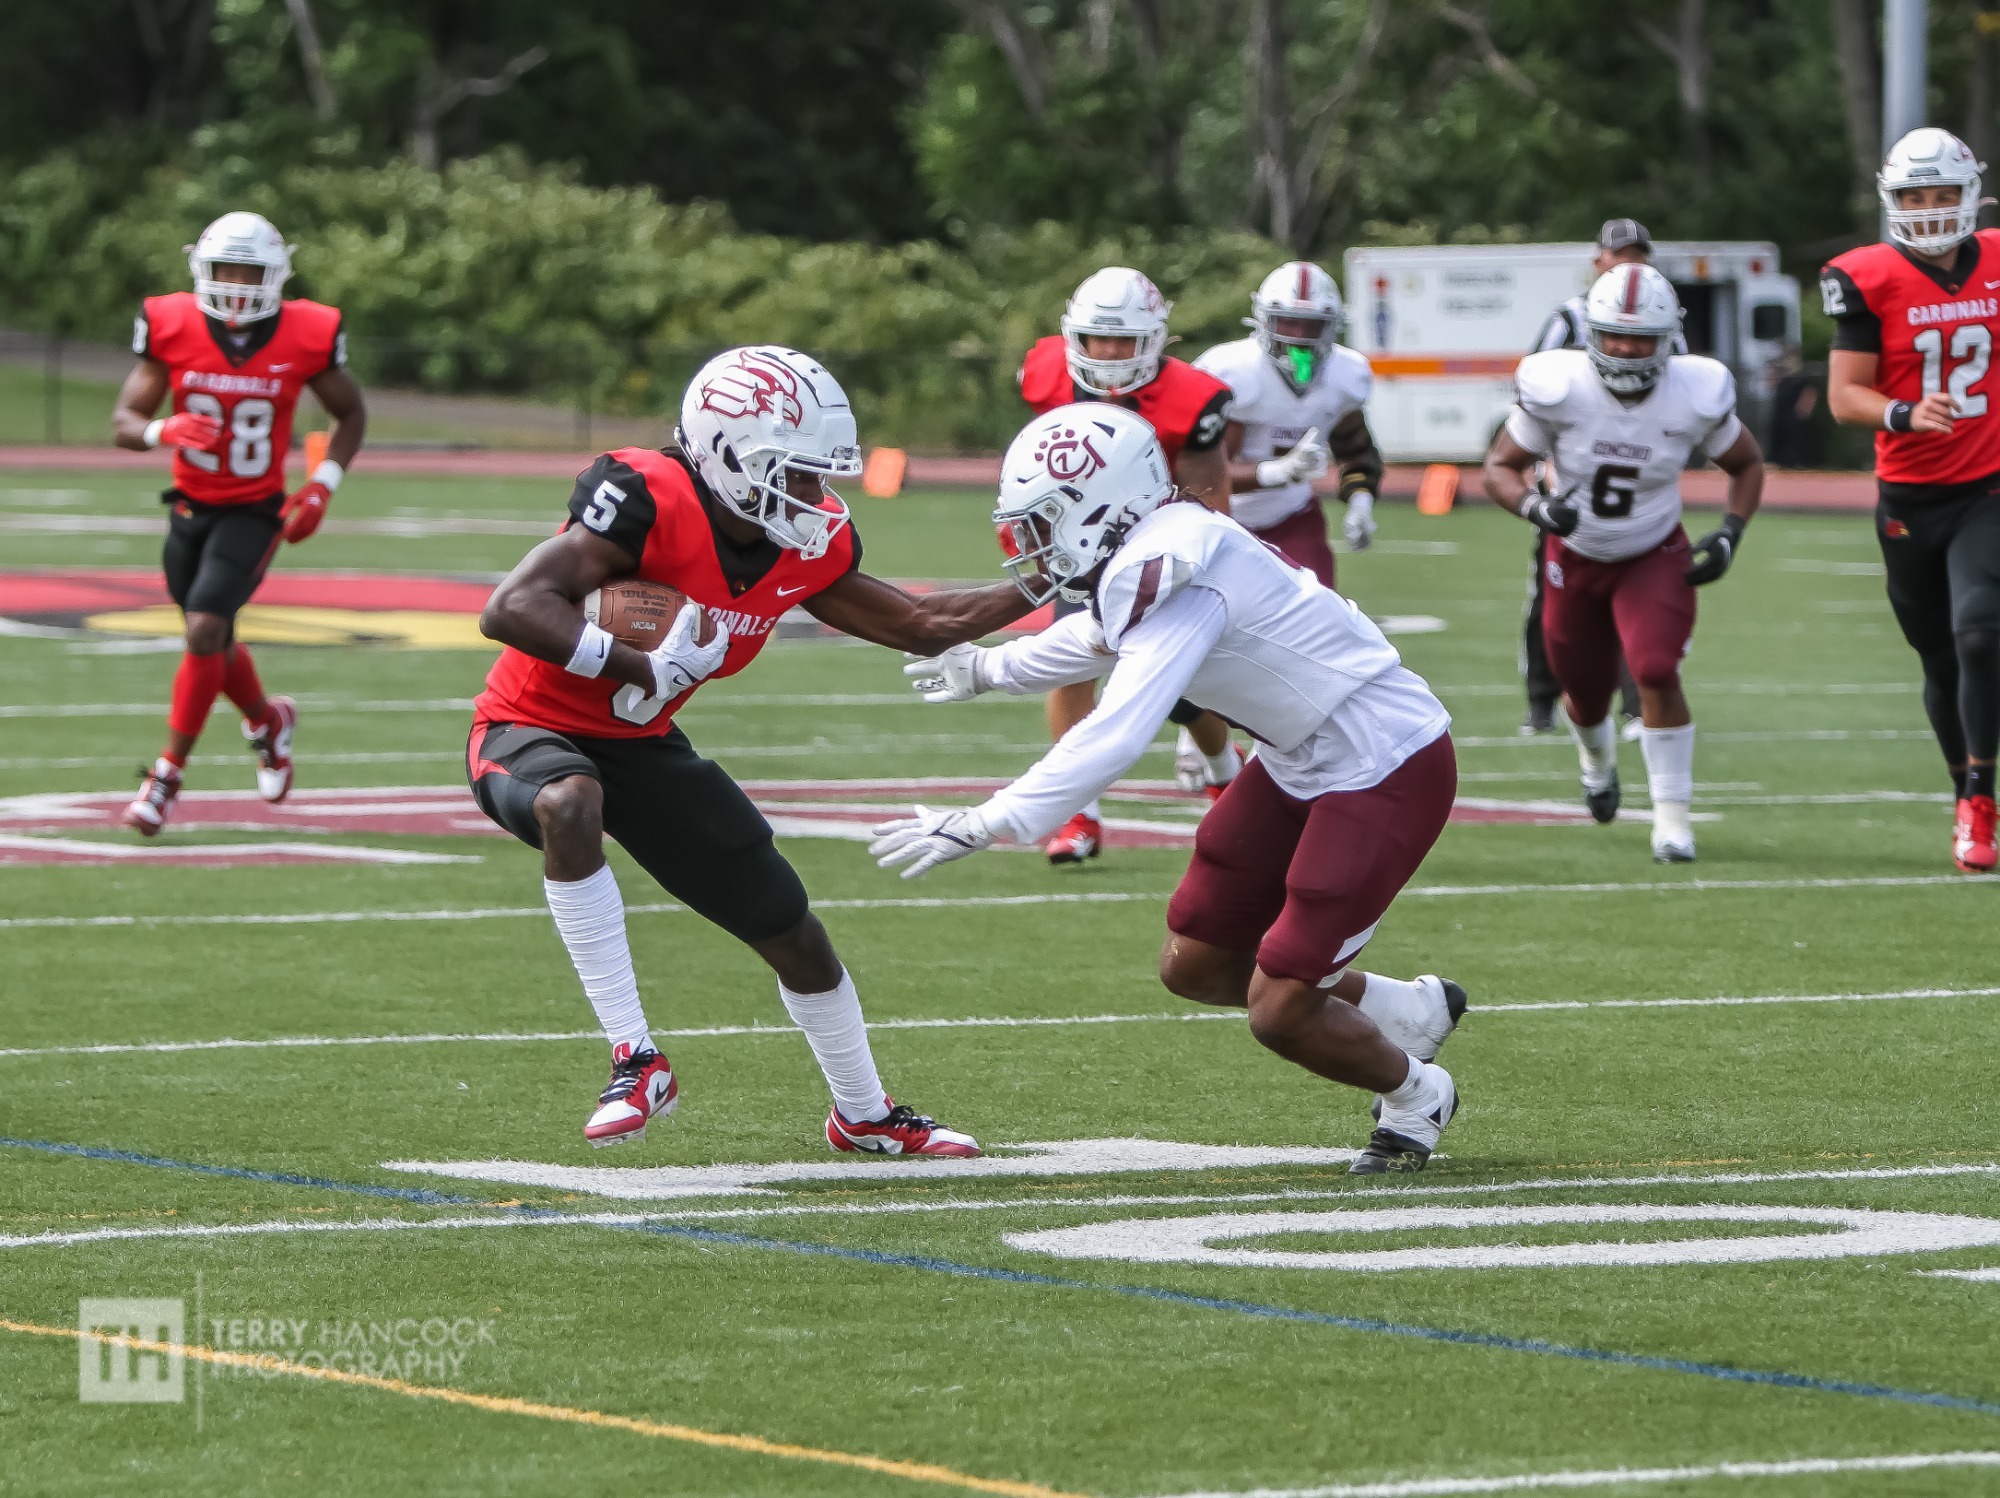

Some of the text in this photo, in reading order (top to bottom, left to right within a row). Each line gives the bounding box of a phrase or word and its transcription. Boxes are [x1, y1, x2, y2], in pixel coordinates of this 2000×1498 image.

[1819, 278, 1847, 315] 12
[1907, 297, 1998, 326] CARDINALS
[1913, 323, 1993, 419] 12
[183, 392, 275, 478] 28
[582, 480, 628, 533] 5
[1591, 463, 1641, 518] 6
